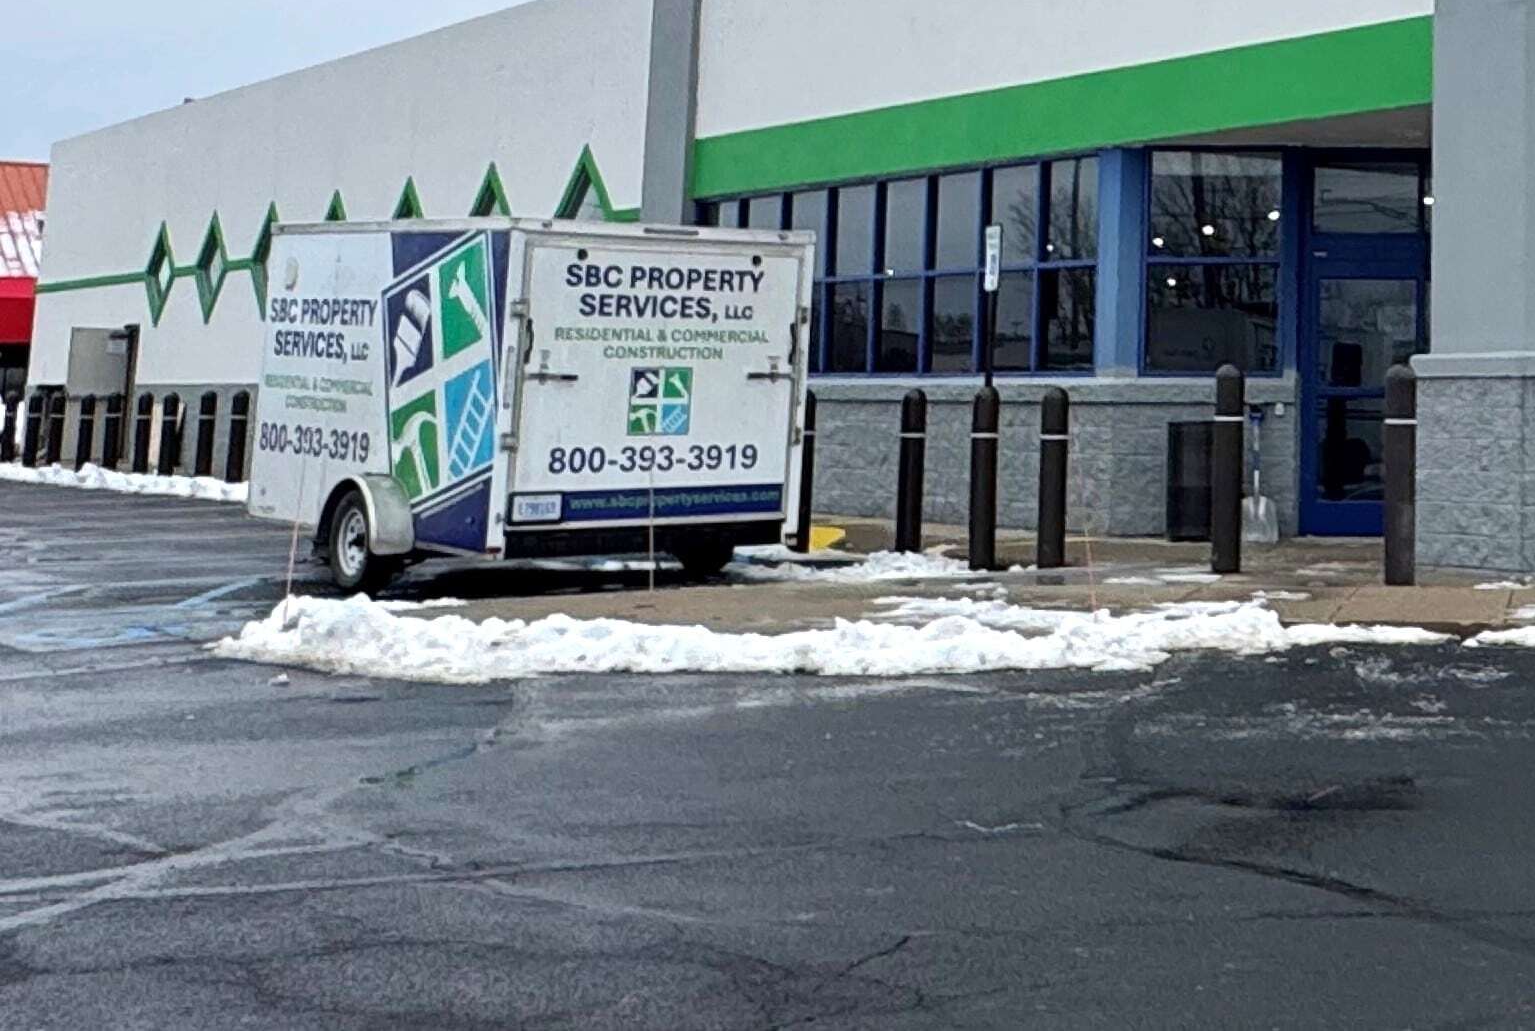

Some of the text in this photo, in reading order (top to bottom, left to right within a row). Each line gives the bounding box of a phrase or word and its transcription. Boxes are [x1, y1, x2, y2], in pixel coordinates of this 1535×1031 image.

[565, 264, 764, 293] SBC PROPERTY
[270, 298, 378, 327] SBC PROPERTY
[579, 293, 753, 323] SERVICES, LLC
[273, 329, 369, 364] SERVICES, LLC
[554, 326, 769, 344] RESIDENTIAL & COMMERCIAL
[603, 345, 723, 360] CONSTRUCTION
[259, 422, 370, 463] 800-393-3919
[548, 443, 758, 474] 800-393-3919
